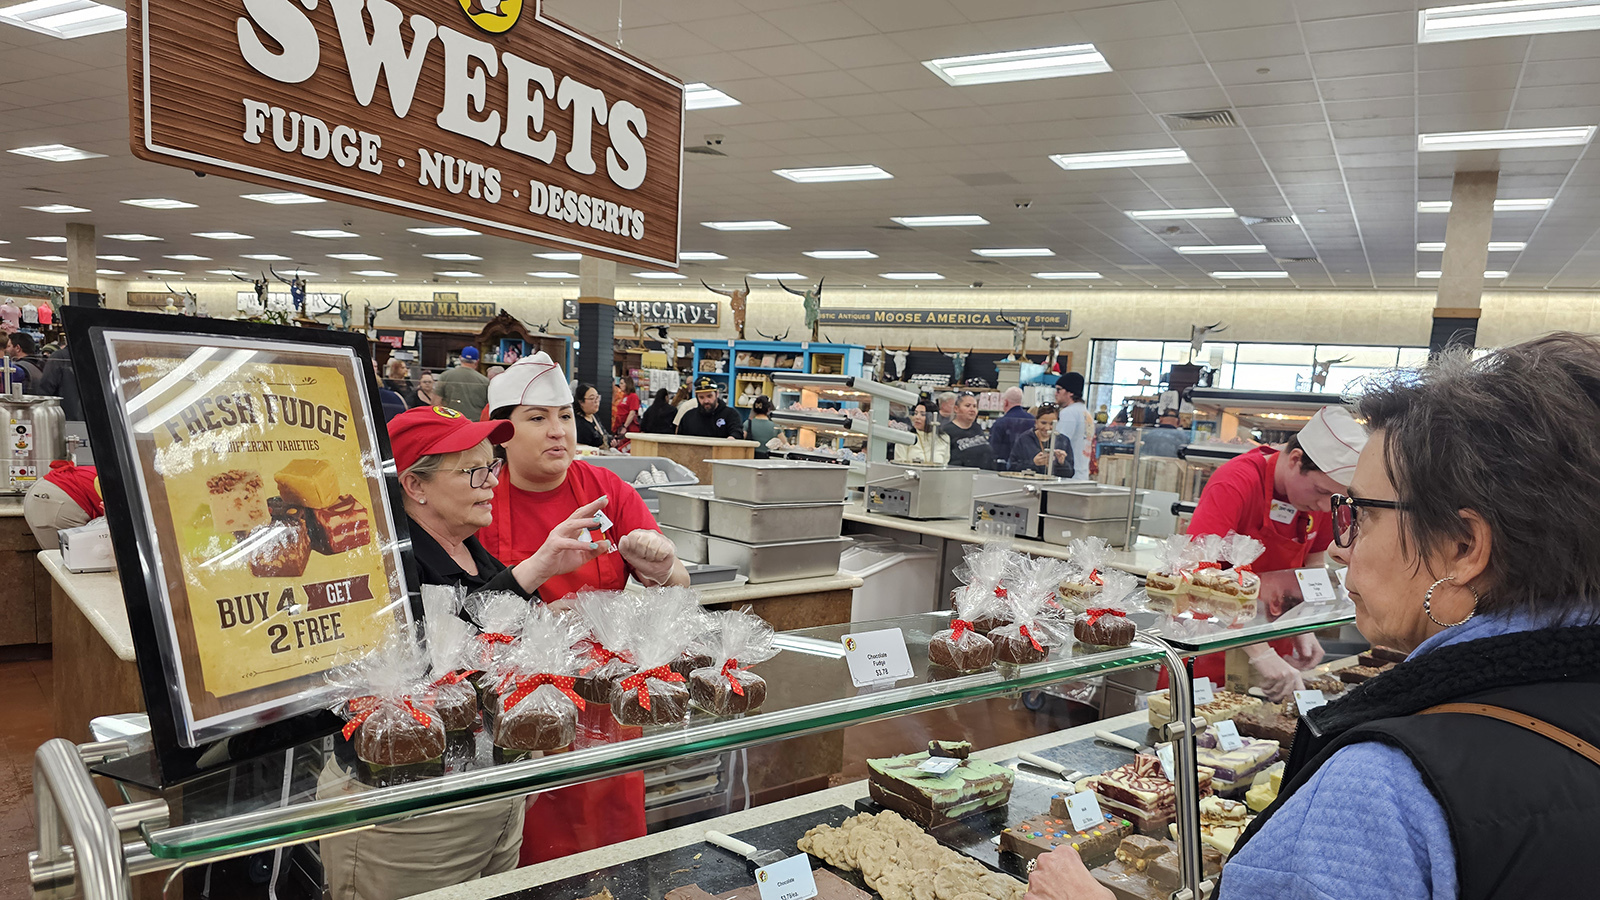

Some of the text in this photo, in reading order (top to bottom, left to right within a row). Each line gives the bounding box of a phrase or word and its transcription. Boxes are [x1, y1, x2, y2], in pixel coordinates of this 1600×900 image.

[237, 0, 647, 190] SWEETS
[243, 98, 645, 240] FUDGE NUTS DESSERTS
[400, 302, 434, 315] MEAT
[616, 300, 702, 324] THECARY
[838, 312, 871, 320] ANTIQUES
[874, 311, 922, 323] MOOSE
[925, 311, 991, 324] AMERICA
[1034, 315, 1060, 323] STORE
[163, 392, 349, 443] FRESH FUDGE
[228, 440, 274, 453] DIFFERENT
[277, 439, 320, 452] VARIETIES
[216, 580, 353, 630] BUY 4 GET
[267, 612, 345, 655] 2 FREE
[867, 652, 888, 660] Chocolate
[776, 877, 795, 888] Chocolate
